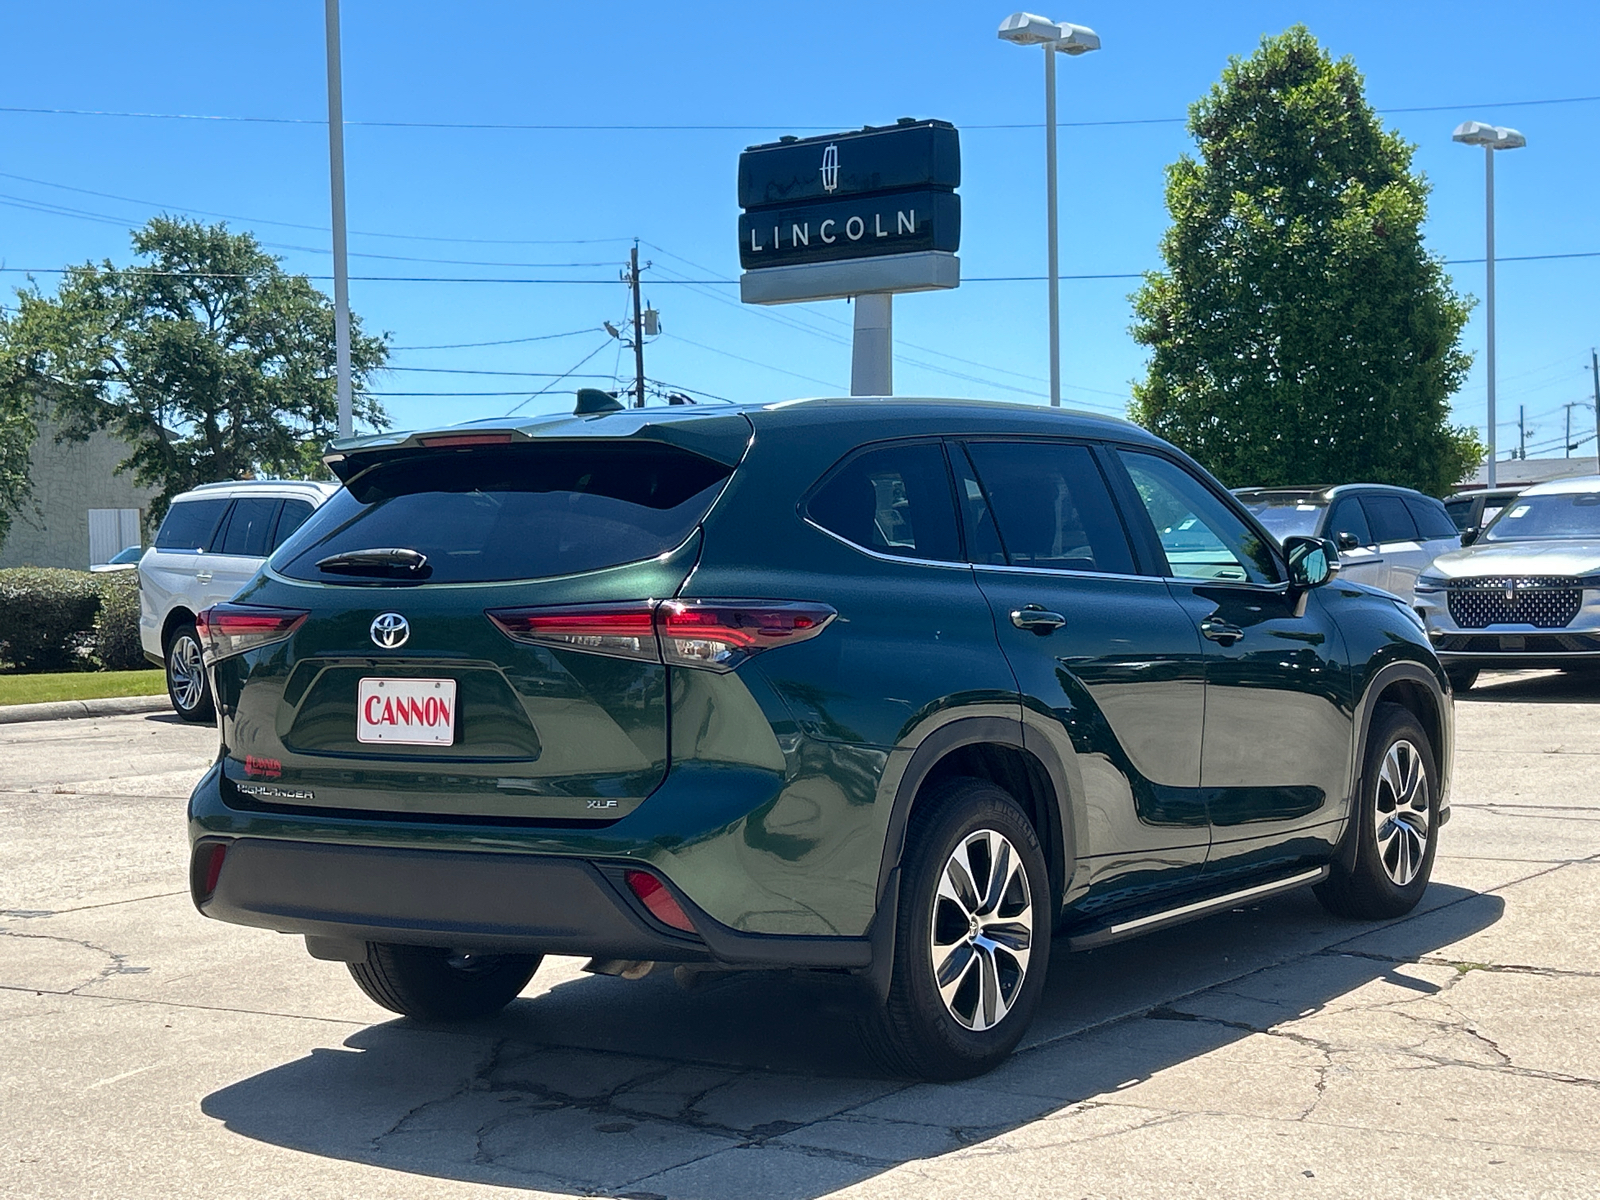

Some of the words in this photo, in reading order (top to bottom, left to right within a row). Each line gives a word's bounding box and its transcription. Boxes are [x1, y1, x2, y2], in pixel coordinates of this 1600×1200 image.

[751, 209, 916, 252] LINCOLN
[364, 695, 451, 727] CANNON
[237, 784, 315, 799] HIGHLANDER
[586, 800, 618, 809] XLE
